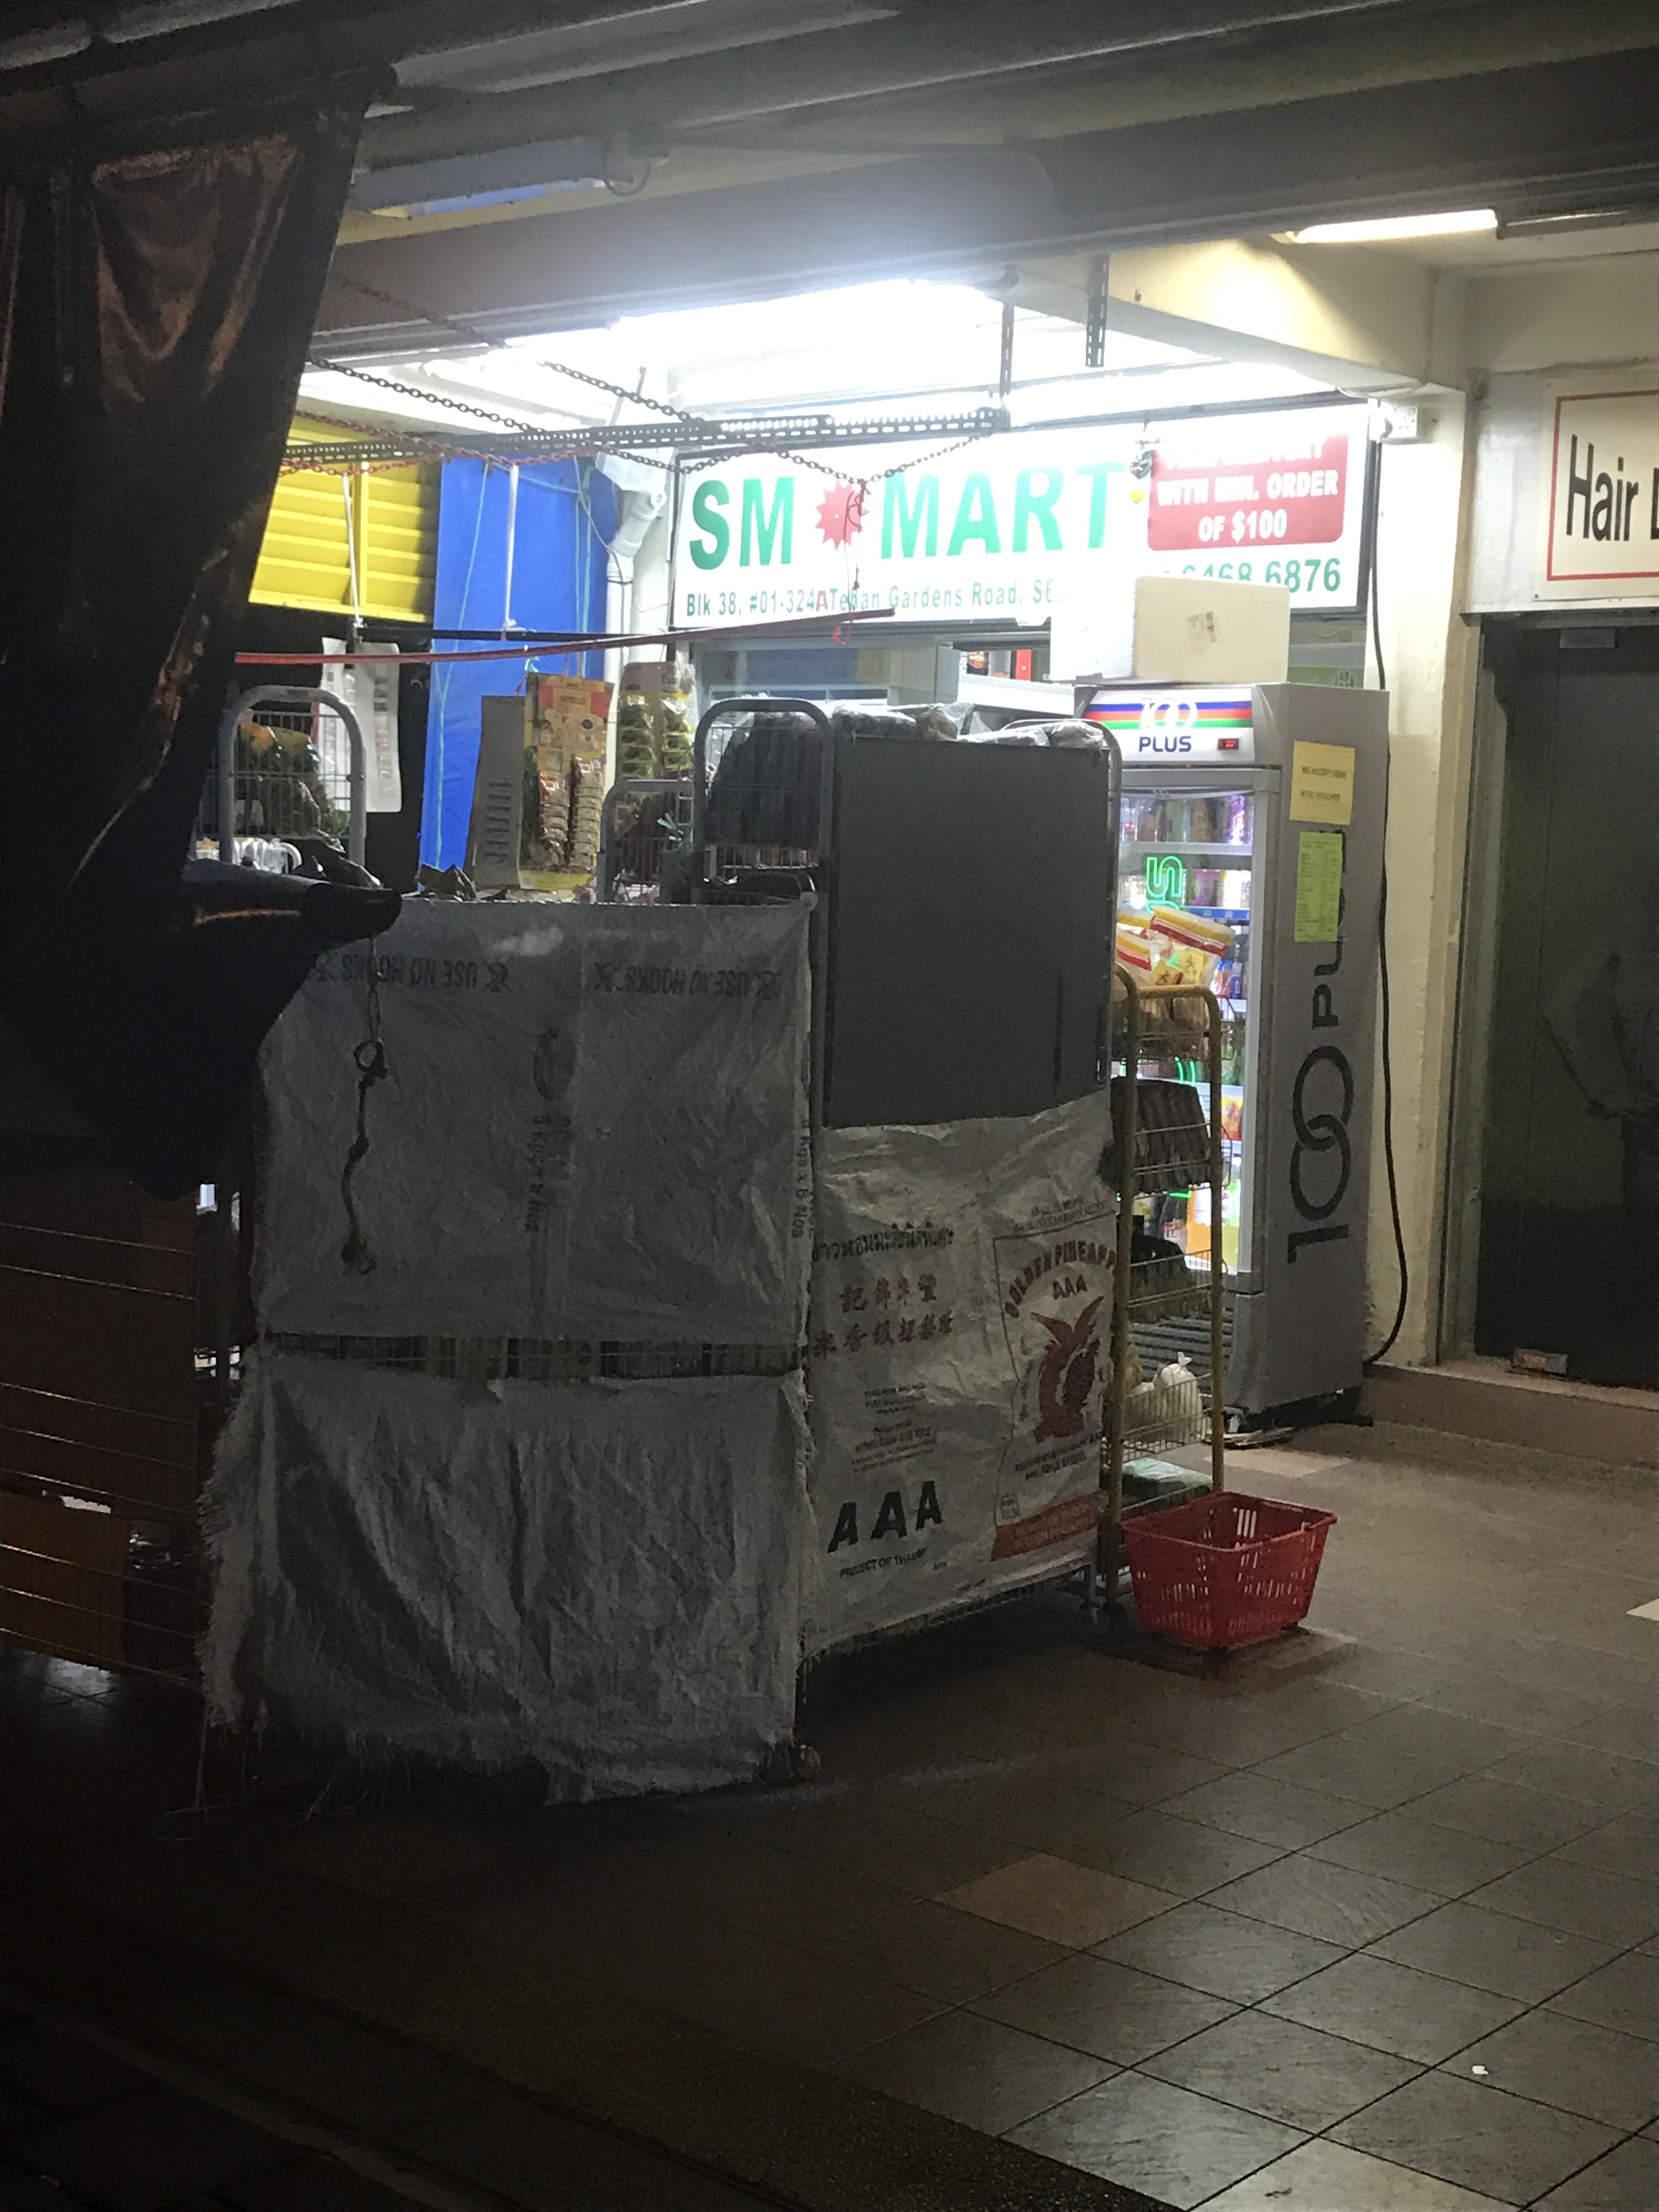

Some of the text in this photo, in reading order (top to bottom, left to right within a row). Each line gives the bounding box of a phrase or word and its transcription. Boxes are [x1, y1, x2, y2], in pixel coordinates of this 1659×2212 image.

[1158, 478, 1209, 506] WITH
[1267, 469, 1339, 499] ORDER
[1566, 433, 1639, 542] Hair
[689, 461, 1126, 571] SM MART
[1198, 509, 1288, 544] OF $100
[1265, 557, 1341, 593] 6876
[686, 593, 711, 617] Blk
[830, 588, 880, 612] Teban
[888, 584, 962, 608] Gardens
[1138, 697, 1198, 731] 100
[1138, 736, 1192, 753] PLUS
[1288, 1045, 1354, 1265] 100
[1052, 1274, 1088, 1300] AAA
